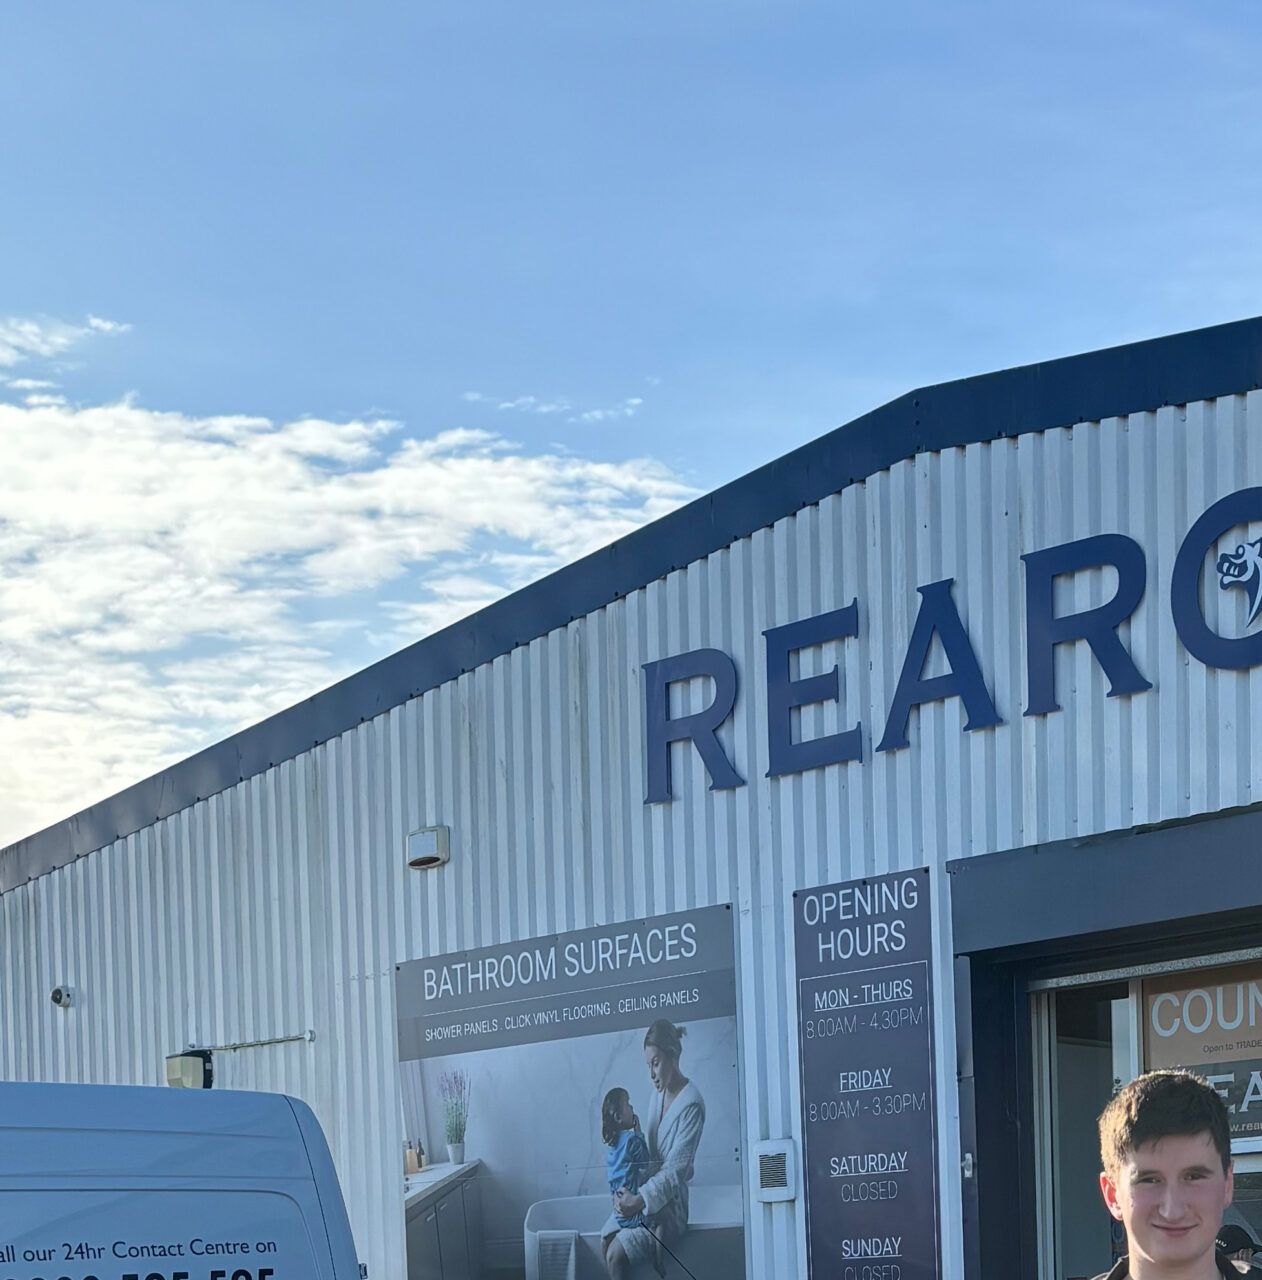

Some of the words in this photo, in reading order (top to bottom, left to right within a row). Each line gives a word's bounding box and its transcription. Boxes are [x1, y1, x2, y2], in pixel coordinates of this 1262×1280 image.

[803, 877, 919, 925] OPENING
[818, 919, 906, 963] HOURS
[424, 947, 556, 1001] BATHROOM
[564, 922, 697, 976] SURFACES
[814, 987, 850, 1010] MON
[861, 978, 914, 1003] THURS
[425, 1024, 462, 1042] SHOWER
[464, 1018, 498, 1035] PANELS
[504, 1013, 531, 1030] CLICK
[533, 1009, 560, 1025] VINYL
[562, 1001, 611, 1021] FLOORING
[618, 994, 657, 1013] CEILING
[660, 988, 700, 1008] PANELS
[806, 1014, 857, 1039] 8.00AM
[869, 1006, 924, 1031] 4.30PM
[1202, 1043, 1224, 1054] Open
[1225, 1041, 1234, 1050] to
[1236, 1038, 1262, 1050] TRADE
[839, 1067, 893, 1092] FRIDAY
[809, 1099, 860, 1122] 8.00AM
[872, 1092, 927, 1117] 3.30PM
[829, 1151, 908, 1176] SATURDAY
[841, 1180, 899, 1202] CLOSED
[0, 1245, 16, 1263] all
[23, 1248, 57, 1262] our
[62, 1242, 106, 1261] 24hr
[112, 1240, 184, 1259] Contact
[189, 1238, 250, 1256] Centre
[255, 1240, 278, 1253] on
[841, 1236, 902, 1258] SUNDAY
